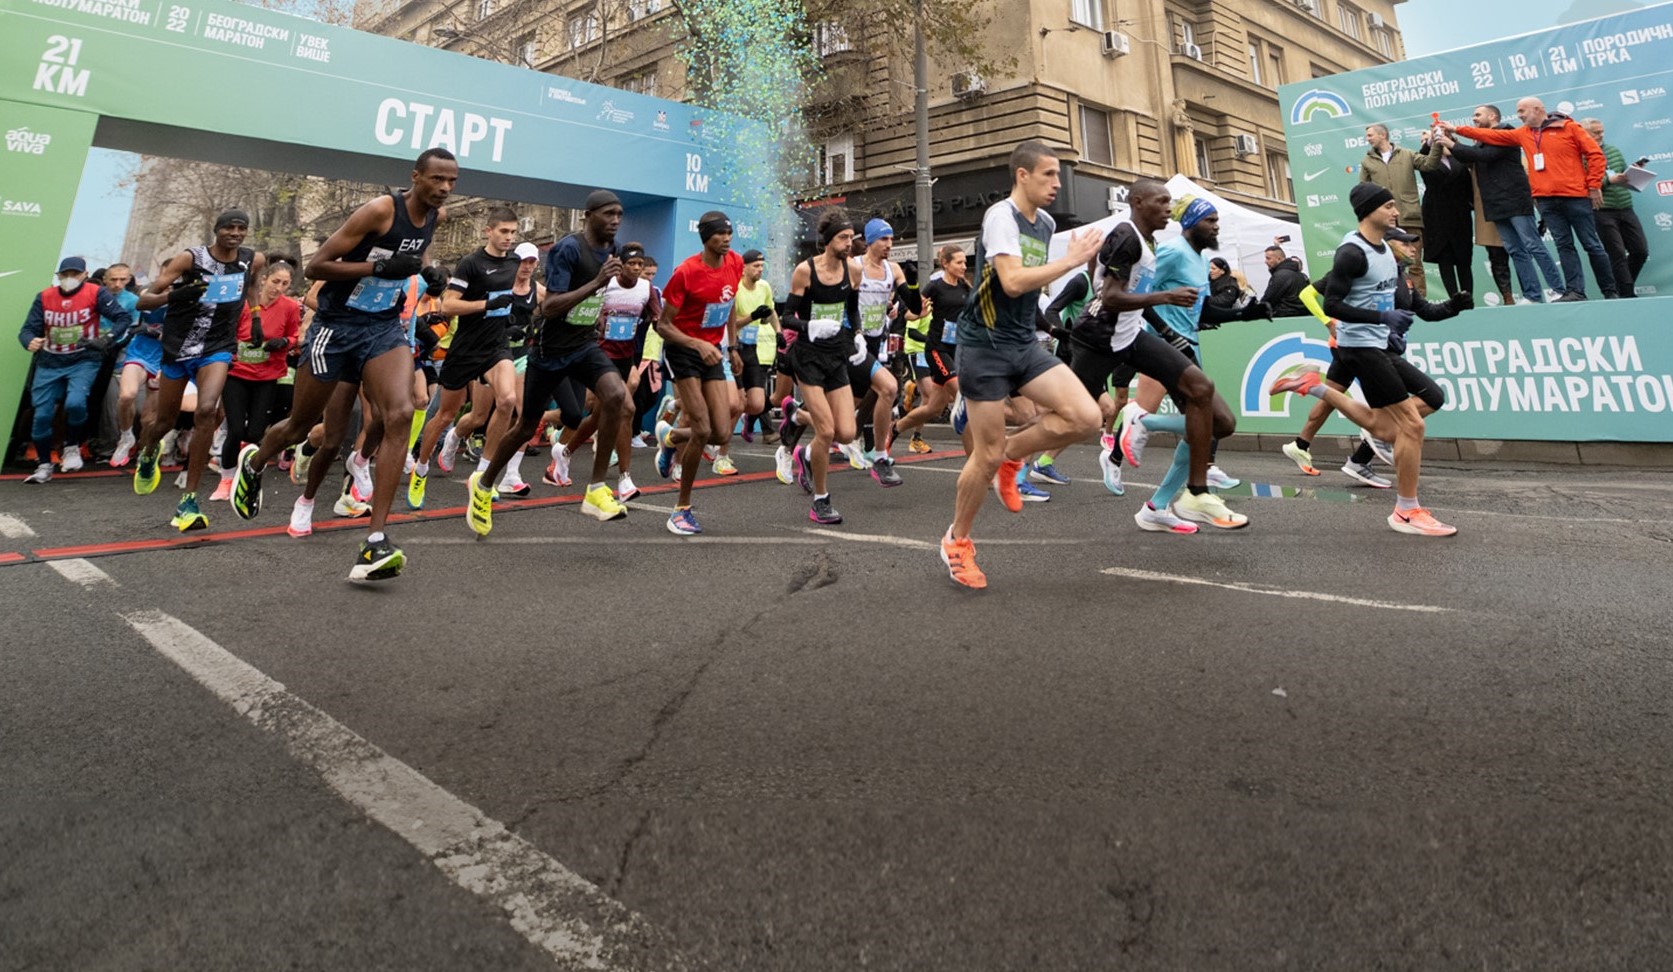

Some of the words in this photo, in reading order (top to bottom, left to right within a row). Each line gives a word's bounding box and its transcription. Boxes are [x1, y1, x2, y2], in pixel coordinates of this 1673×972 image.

[32, 0, 151, 25] ОЛУМАРАТОН
[168, 5, 190, 20] 20
[165, 18, 187, 33] 22
[207, 13, 289, 41] БЕОГРАДСКИ
[204, 26, 265, 49] МАРАТОН
[299, 33, 329, 50] УВЕК
[42, 35, 83, 66] 21
[296, 46, 331, 63] ВИШЕ
[1548, 45, 1566, 61] 21
[1586, 48, 1632, 68] ТРКА
[1470, 61, 1491, 76] 20
[1508, 53, 1527, 68] 10
[1551, 59, 1578, 75] КМ
[32, 62, 91, 97] КМ
[1474, 74, 1494, 89] 22
[1513, 65, 1539, 82] КМ
[1361, 70, 1444, 97] БЕОГРАДСКИ
[1364, 81, 1459, 110] ПОЛУМАРАТОН
[374, 98, 513, 163] СТАРТ
[7, 140, 44, 154] viva
[686, 153, 701, 172] 10
[686, 174, 709, 193] КМ
[2, 200, 41, 214] SAVA
[398, 238, 424, 252] EA7
[219, 285, 228, 295] 2
[373, 292, 383, 303] 3
[1406, 335, 1643, 375] БЕОГРАДСКИ
[1438, 374, 1673, 413] ОЛУМАРАТО
